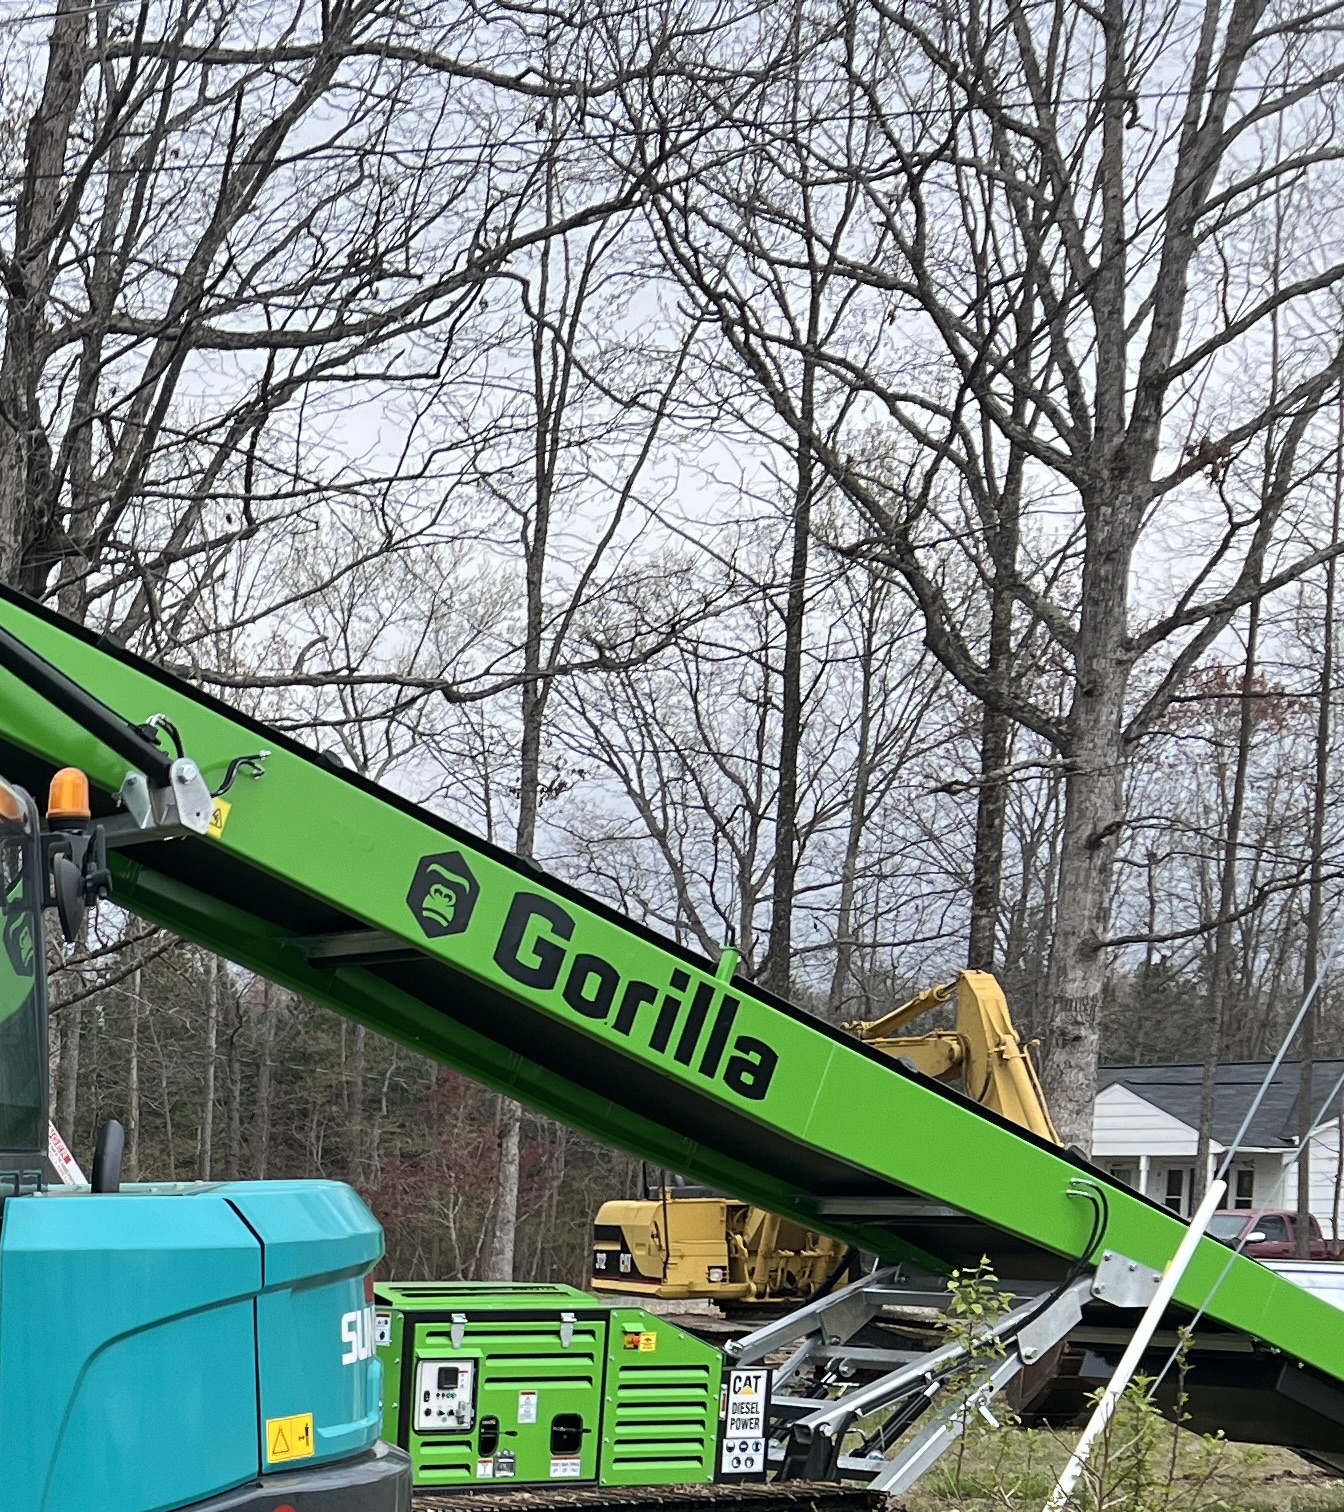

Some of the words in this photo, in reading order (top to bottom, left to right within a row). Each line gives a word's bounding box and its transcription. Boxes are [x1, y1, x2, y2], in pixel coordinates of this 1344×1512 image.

[493, 891, 779, 1101] Gorilla
[733, 1375, 762, 1395] CAT
[732, 1401, 761, 1415] DIESEL
[730, 1417, 760, 1431] POWER
